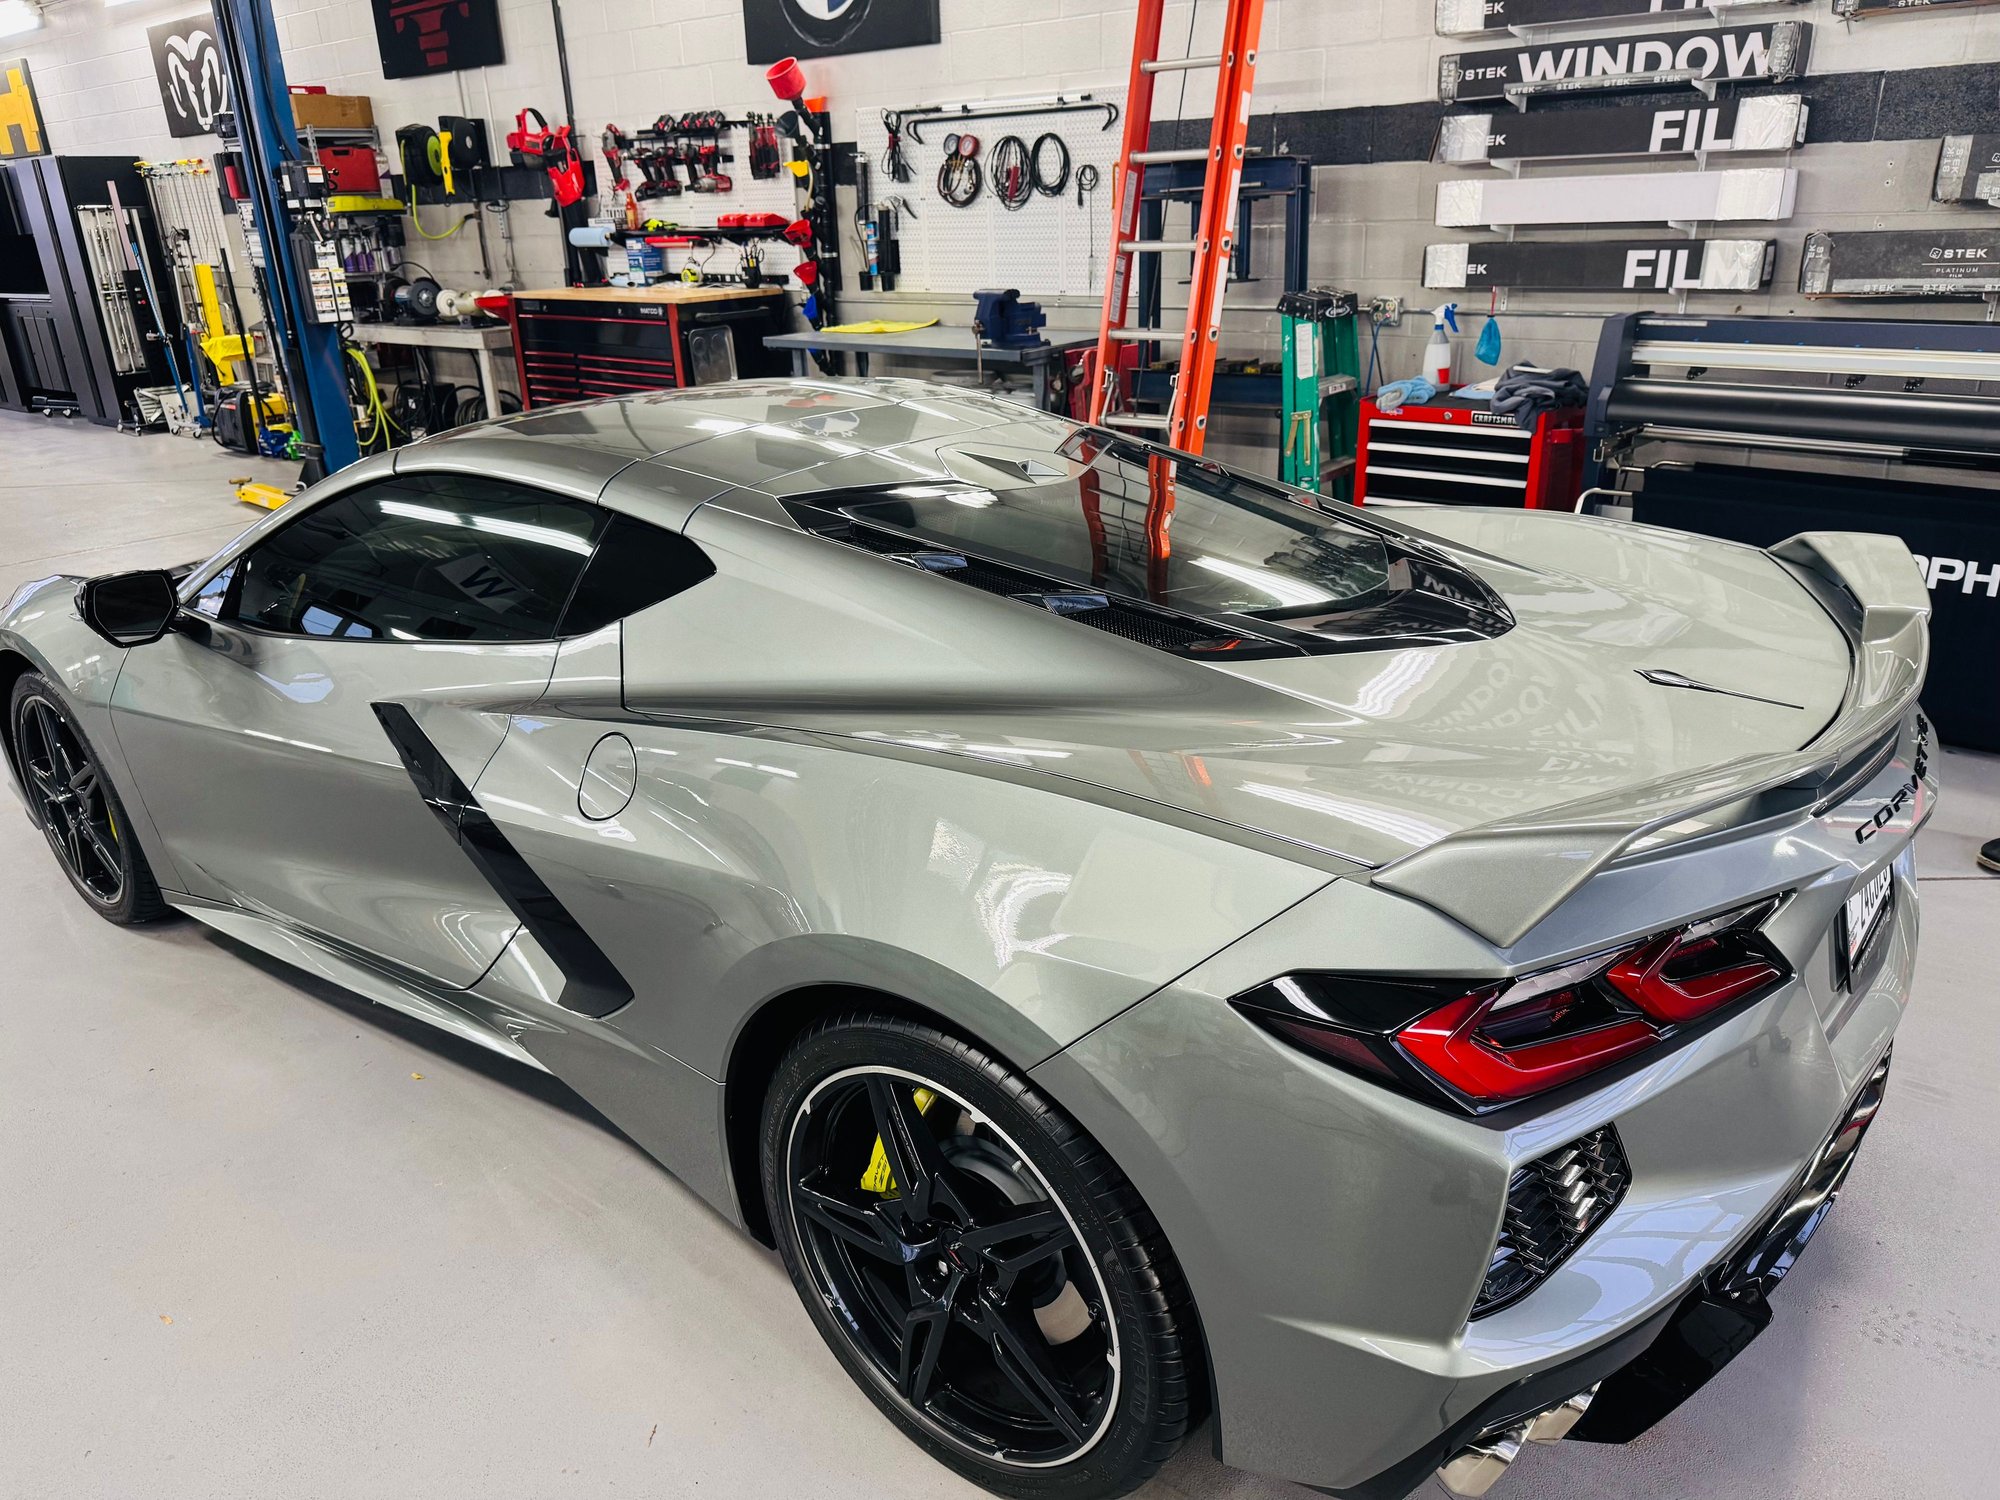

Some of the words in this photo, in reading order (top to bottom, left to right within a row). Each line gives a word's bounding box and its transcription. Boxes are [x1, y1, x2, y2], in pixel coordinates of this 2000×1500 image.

[1465, 65, 1508, 81] STEK
[1517, 31, 1769, 82] WINDOW
[1603, 78, 1630, 88] STEK
[1653, 74, 1681, 83] STEK
[1510, 86, 1535, 95] STEK
[1555, 82, 1581, 91] STEK
[1649, 108, 1732, 152] FIL
[1944, 248, 1988, 260] STEK
[1863, 284, 1895, 292] STEK
[1922, 284, 1956, 292] STEK
[1984, 284, 2000, 292] ST
